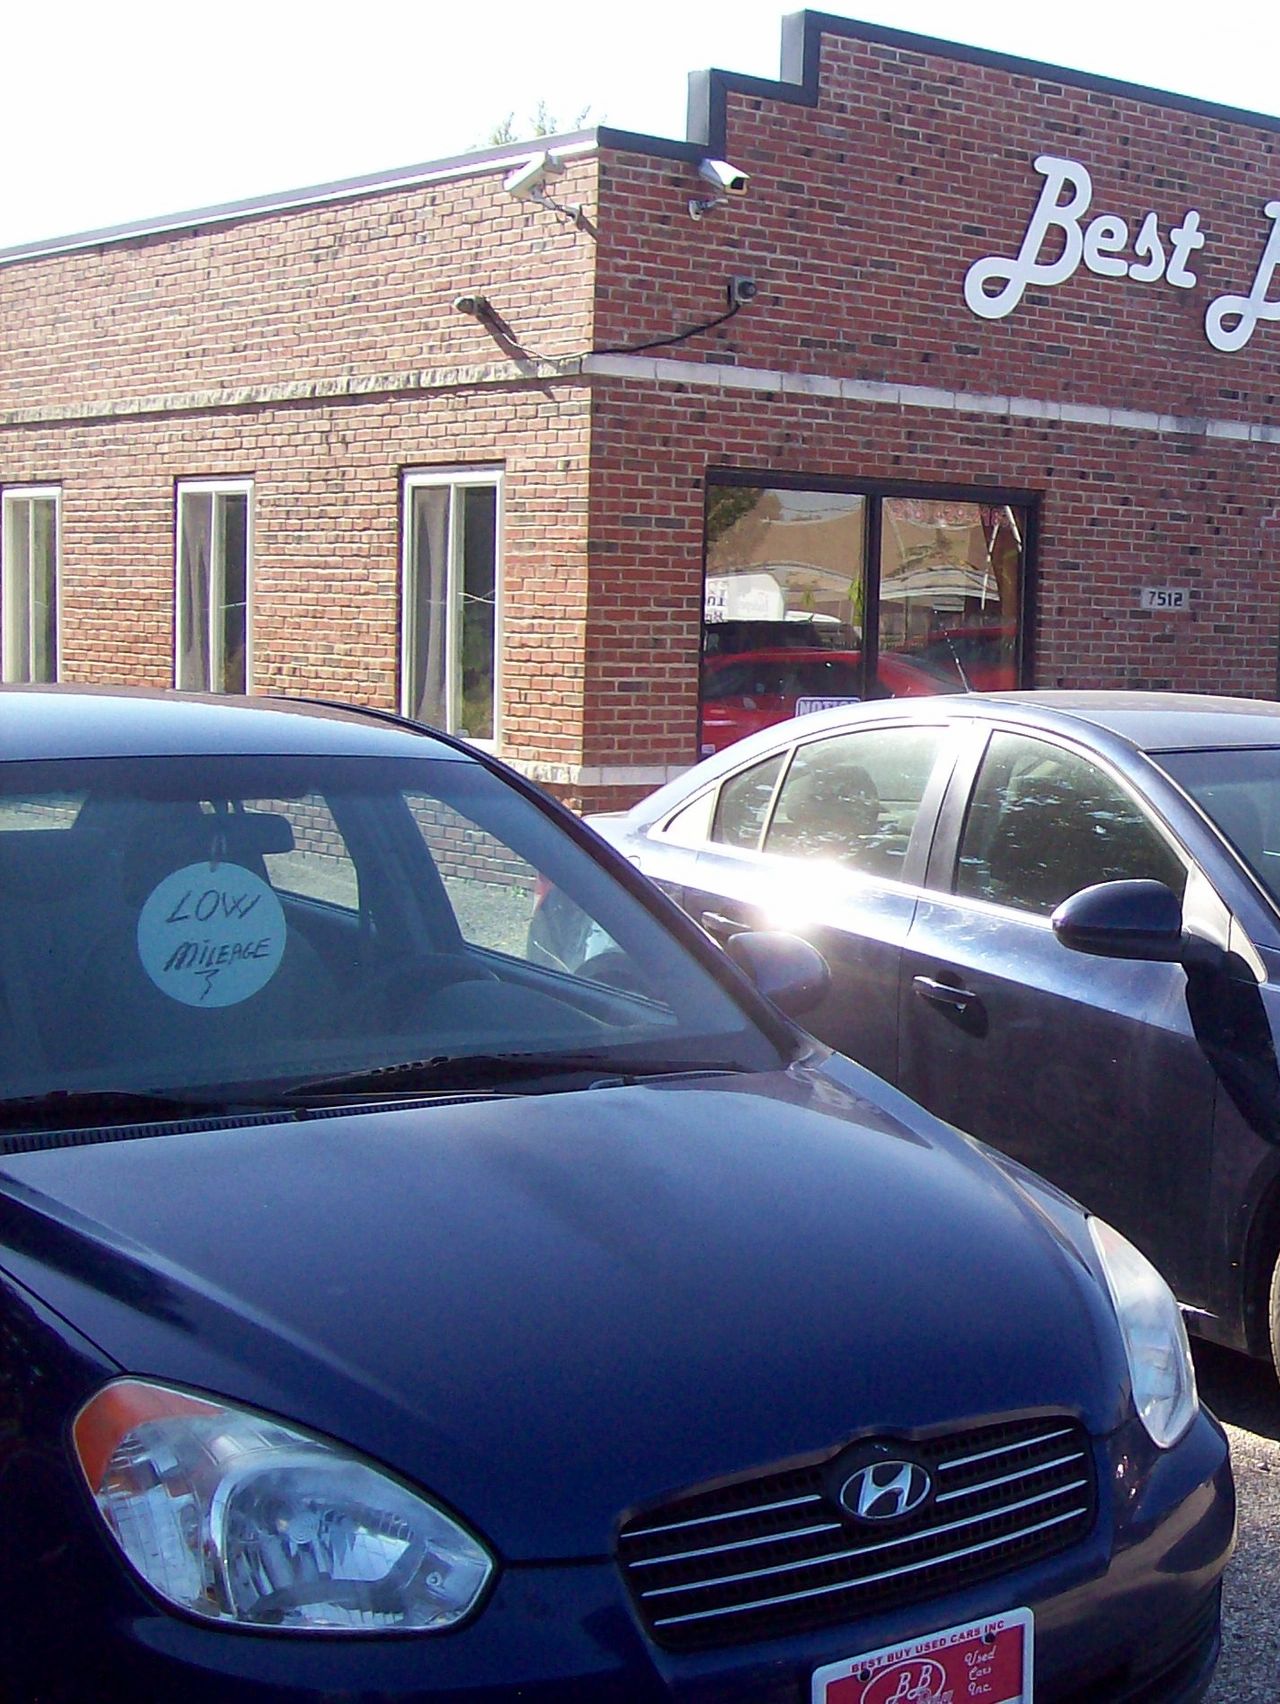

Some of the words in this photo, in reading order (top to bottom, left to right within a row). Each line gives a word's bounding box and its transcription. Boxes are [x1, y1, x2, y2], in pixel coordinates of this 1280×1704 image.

[964, 155, 1204, 319] Best
[1148, 591, 1183, 607] 7512
[166, 889, 263, 924] LOW
[851, 1655, 884, 1674] BEST
[887, 1649, 911, 1663] BUY
[915, 1638, 946, 1655] USED
[950, 1629, 981, 1644] CARS
[984, 1620, 1005, 1634] INC
[964, 1645, 997, 1666] Used
[968, 1667, 992, 1681] Cars
